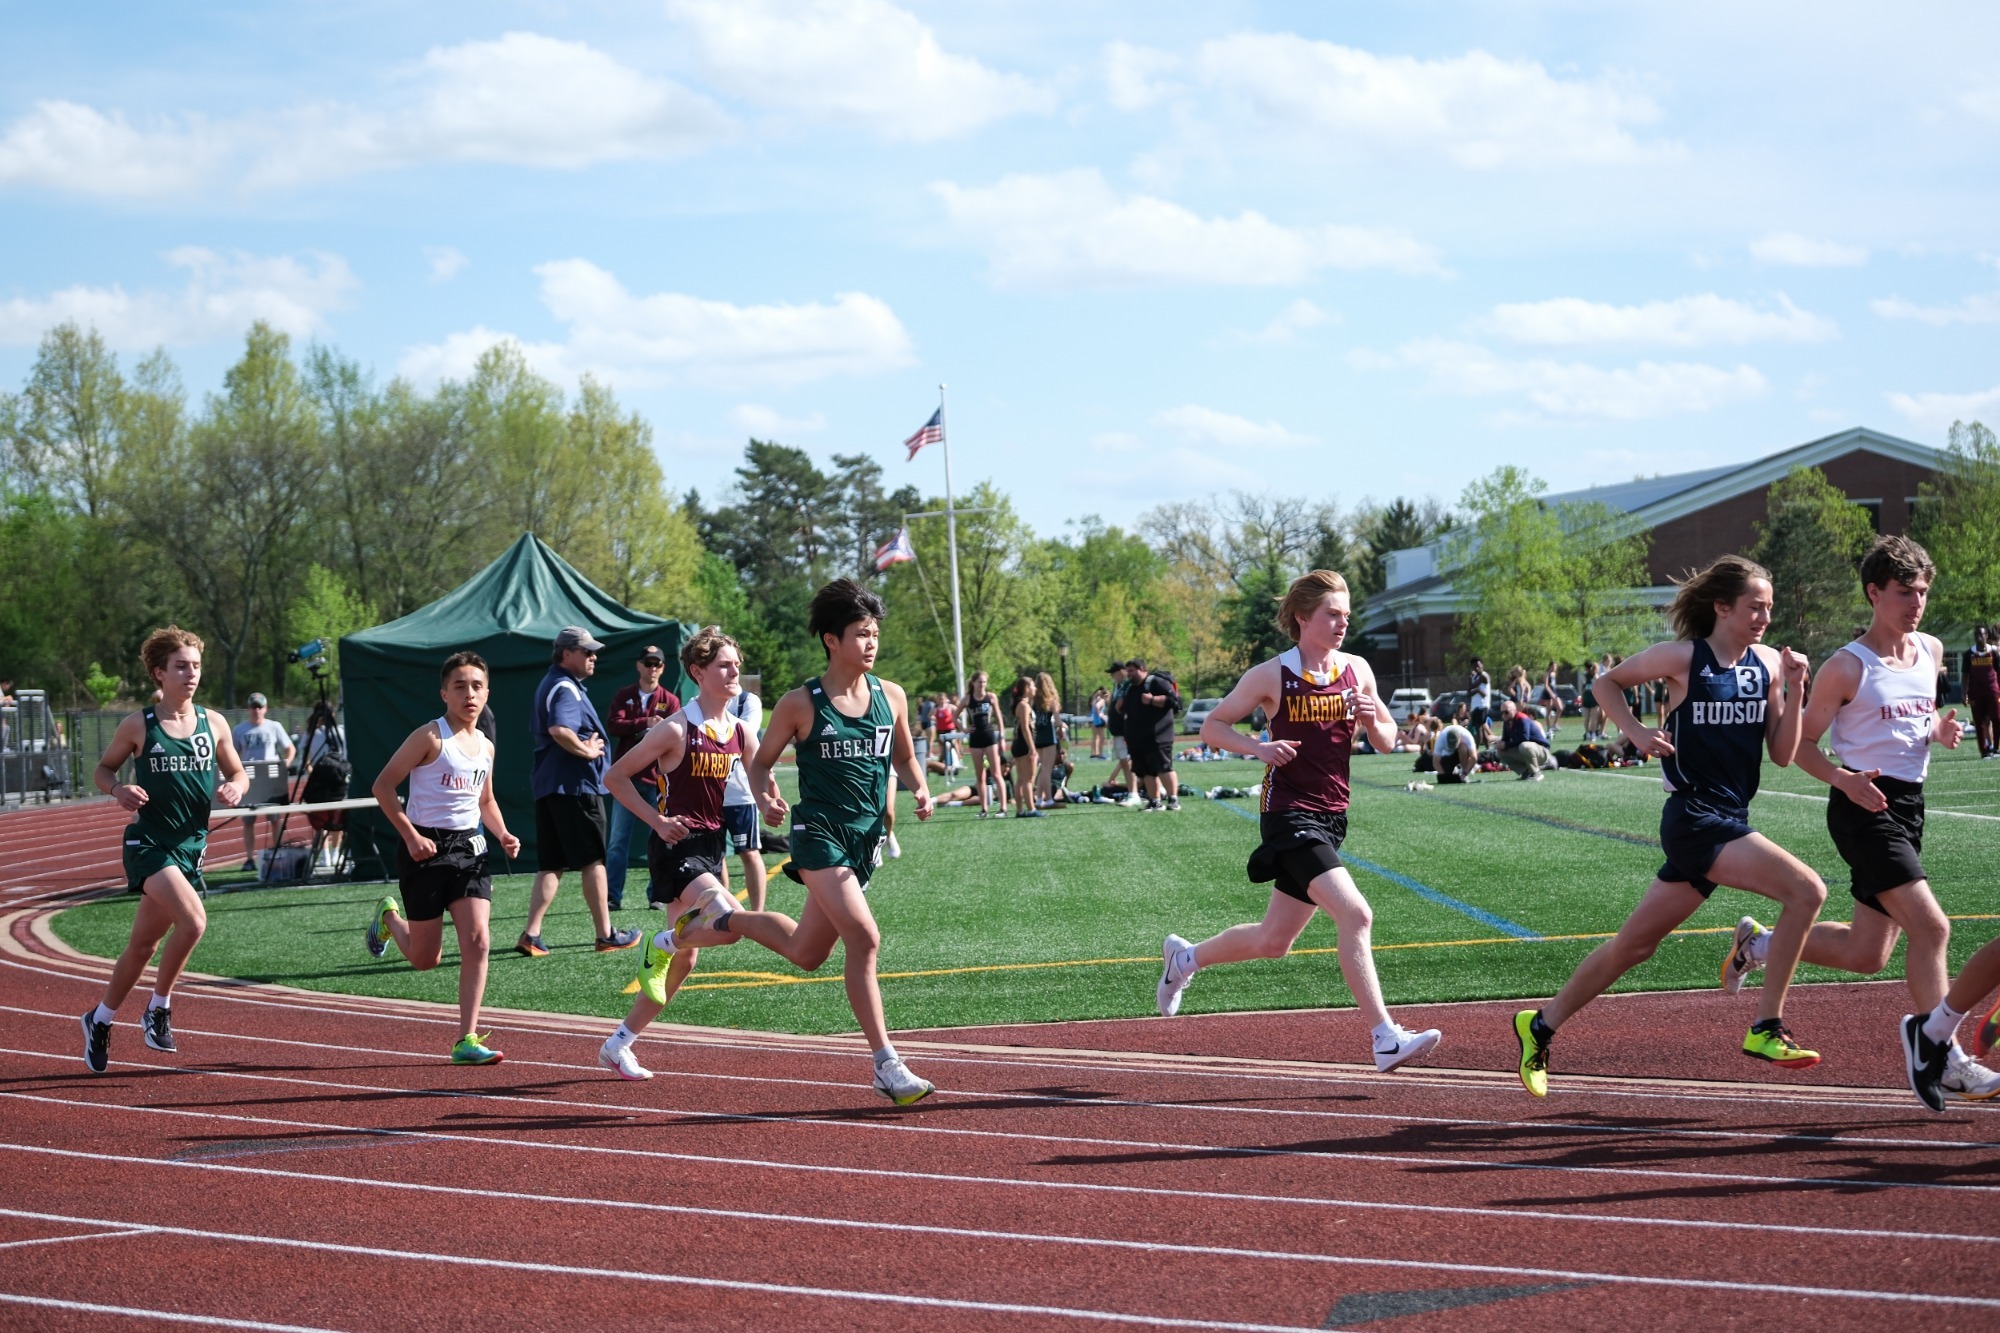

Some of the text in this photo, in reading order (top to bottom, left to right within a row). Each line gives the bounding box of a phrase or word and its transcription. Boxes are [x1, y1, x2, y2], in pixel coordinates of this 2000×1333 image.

[1740, 668, 1759, 695] 3
[1286, 694, 1354, 722] WARRIO
[195, 735, 211, 758] 8
[820, 739, 877, 759] RESER
[878, 728, 891, 754] 7
[473, 768, 486, 786] 10
